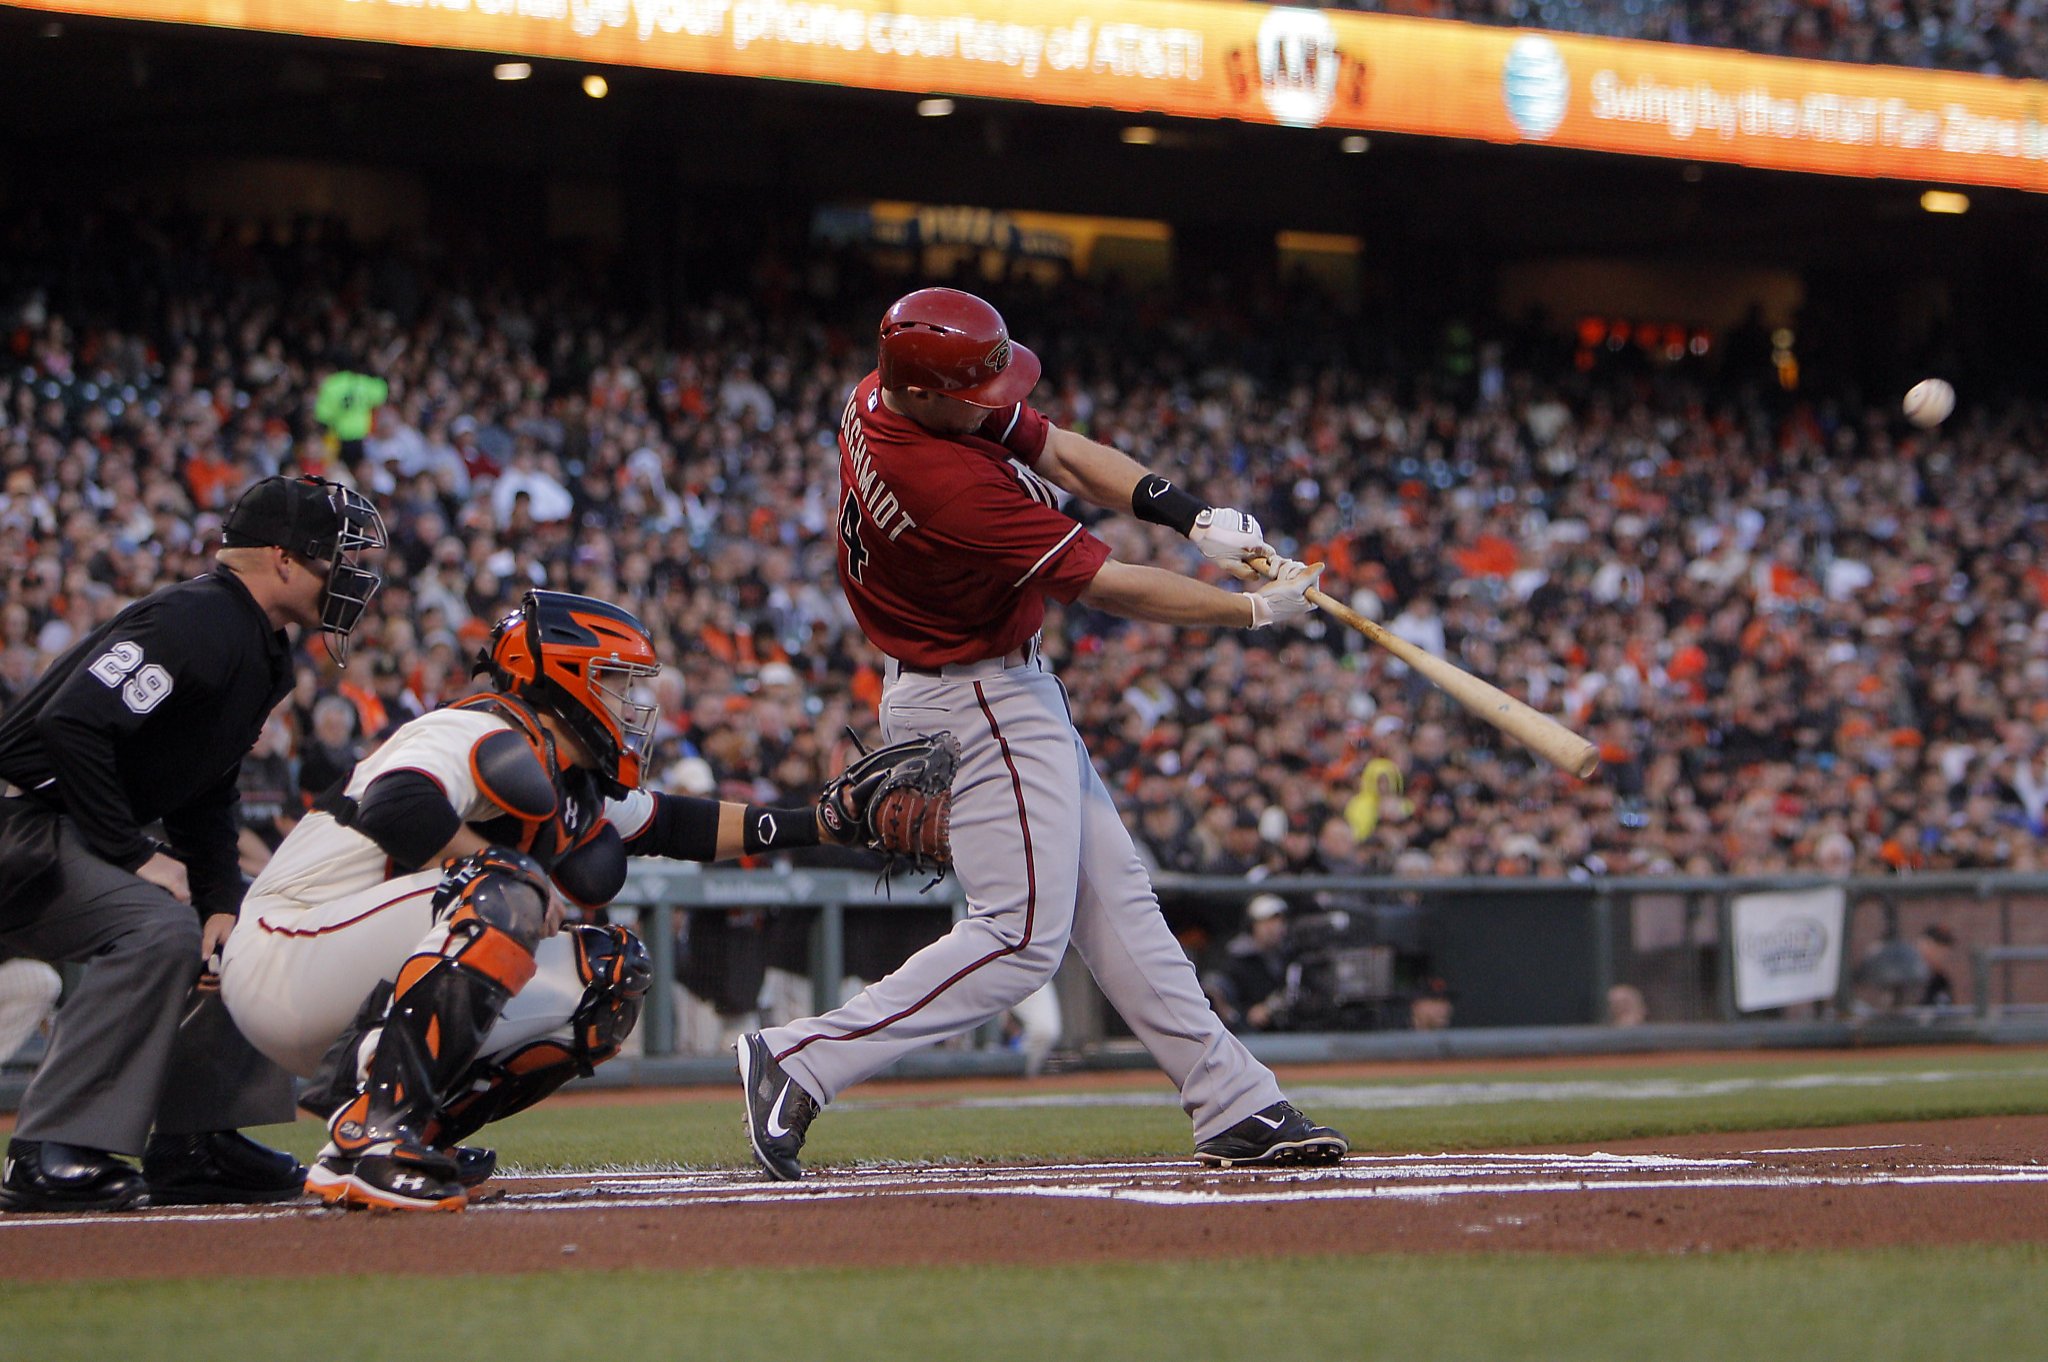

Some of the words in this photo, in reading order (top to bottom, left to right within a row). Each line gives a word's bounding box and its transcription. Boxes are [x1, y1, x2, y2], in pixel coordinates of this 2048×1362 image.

[632, 0, 731, 41] your
[732, 0, 866, 50] phone
[868, 12, 1045, 78] courtesy
[1046, 16, 1093, 70] of
[1589, 69, 1698, 140] Swing
[1695, 80, 1738, 142] by
[1738, 84, 1799, 139] the
[837, 455, 869, 585] 4
[88, 640, 175, 715] 29
